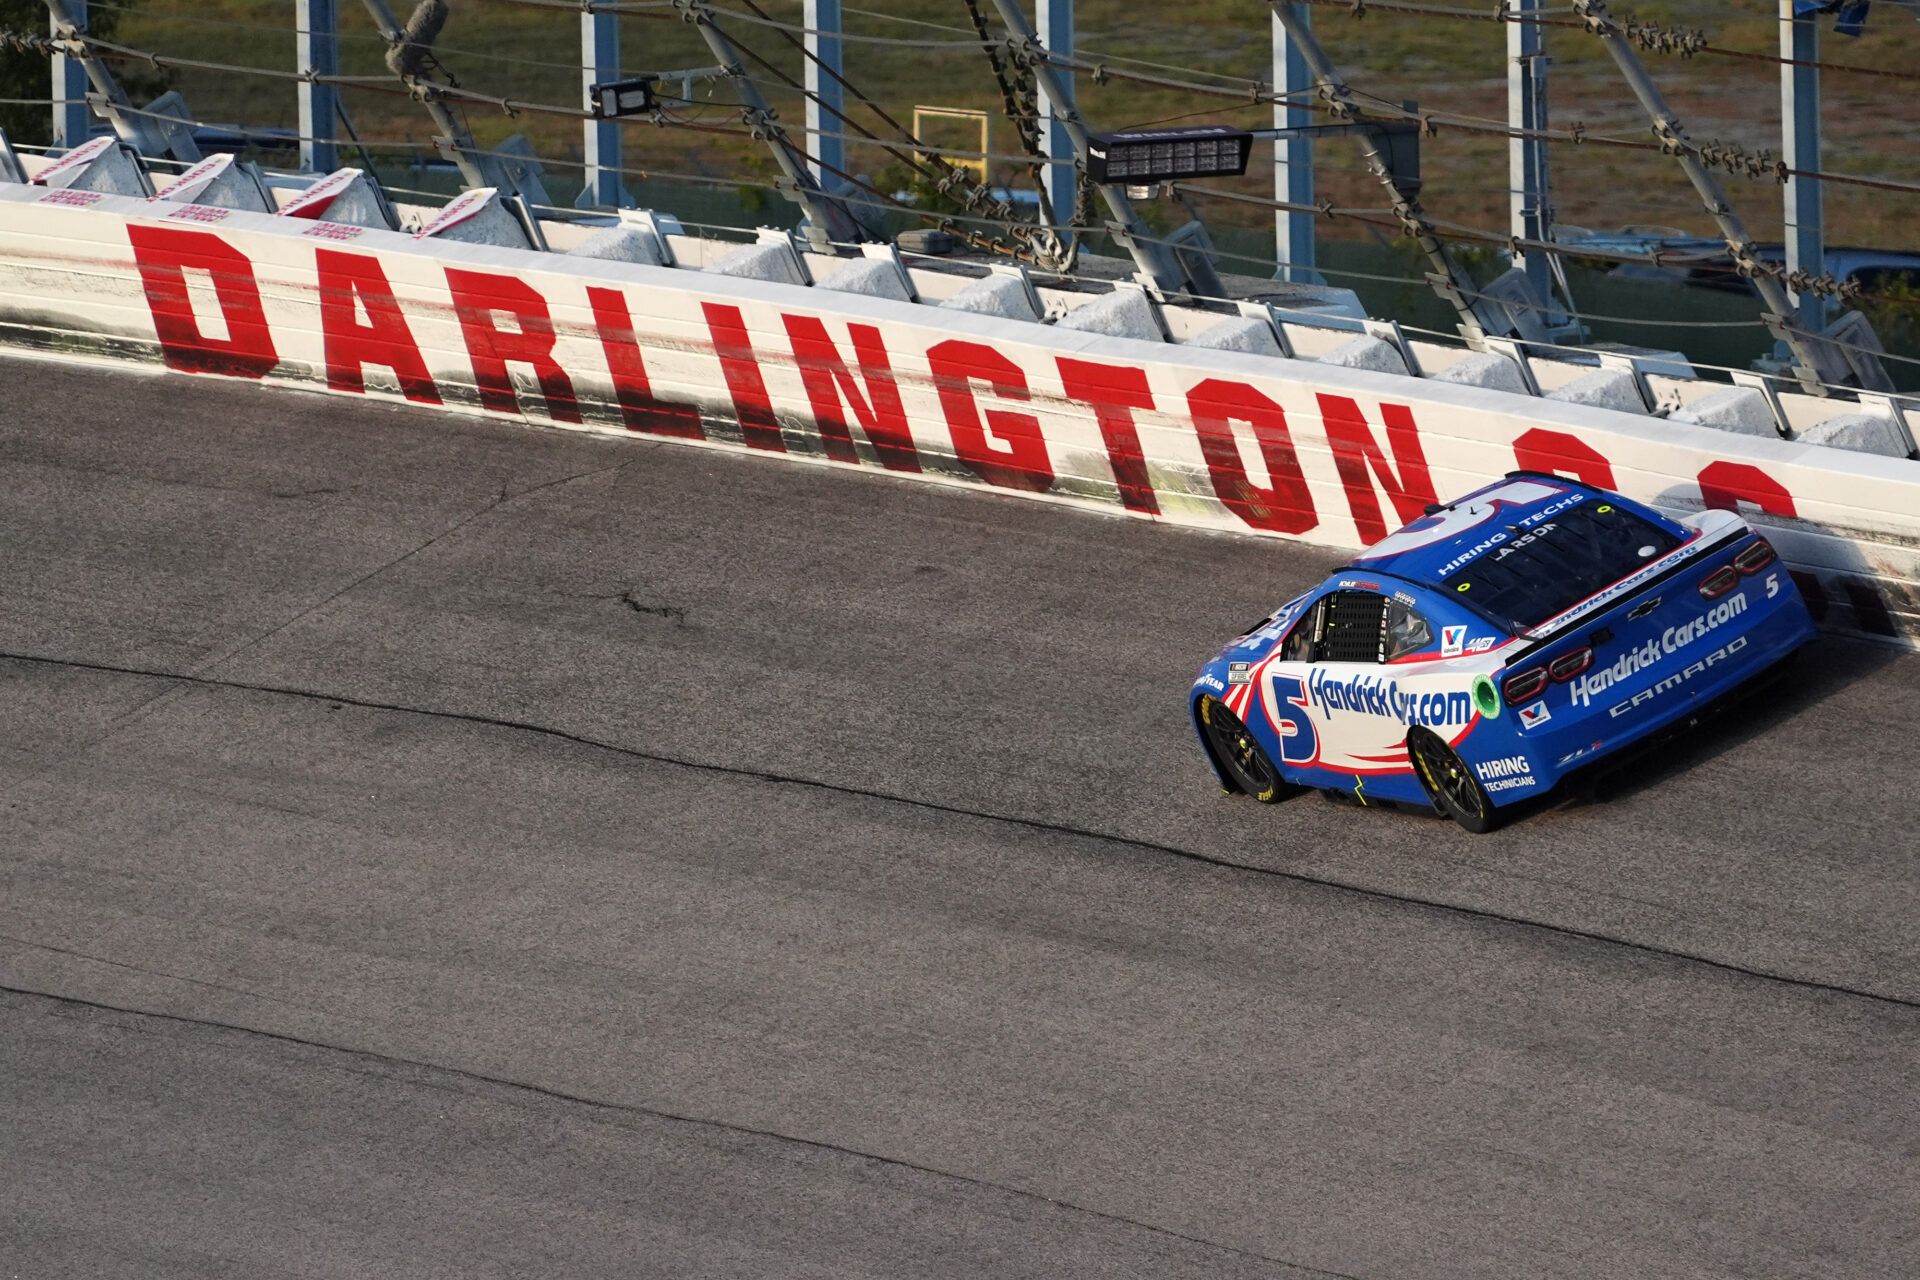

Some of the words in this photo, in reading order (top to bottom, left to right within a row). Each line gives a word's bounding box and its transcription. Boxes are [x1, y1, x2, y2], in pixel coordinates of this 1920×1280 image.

[59, 142, 98, 167] COOK
[177, 161, 217, 188] COOK
[302, 175, 345, 200] COOK
[146, 185, 175, 203] OUT
[438, 197, 476, 222] COOK
[127, 223, 1440, 547] DARLINGTON
[1438, 532, 1507, 577] HIRING
[1518, 493, 1585, 528] TECHS
[1493, 522, 1559, 562] LARSON
[1536, 544, 1699, 636] endrickCars.com
[1765, 573, 1780, 599] 5
[1608, 635, 1748, 718] CAMARO
[1271, 672, 1319, 765] 5
[1476, 755, 1531, 780] HIRING
[1484, 776, 1536, 792] TECHNICIANS
